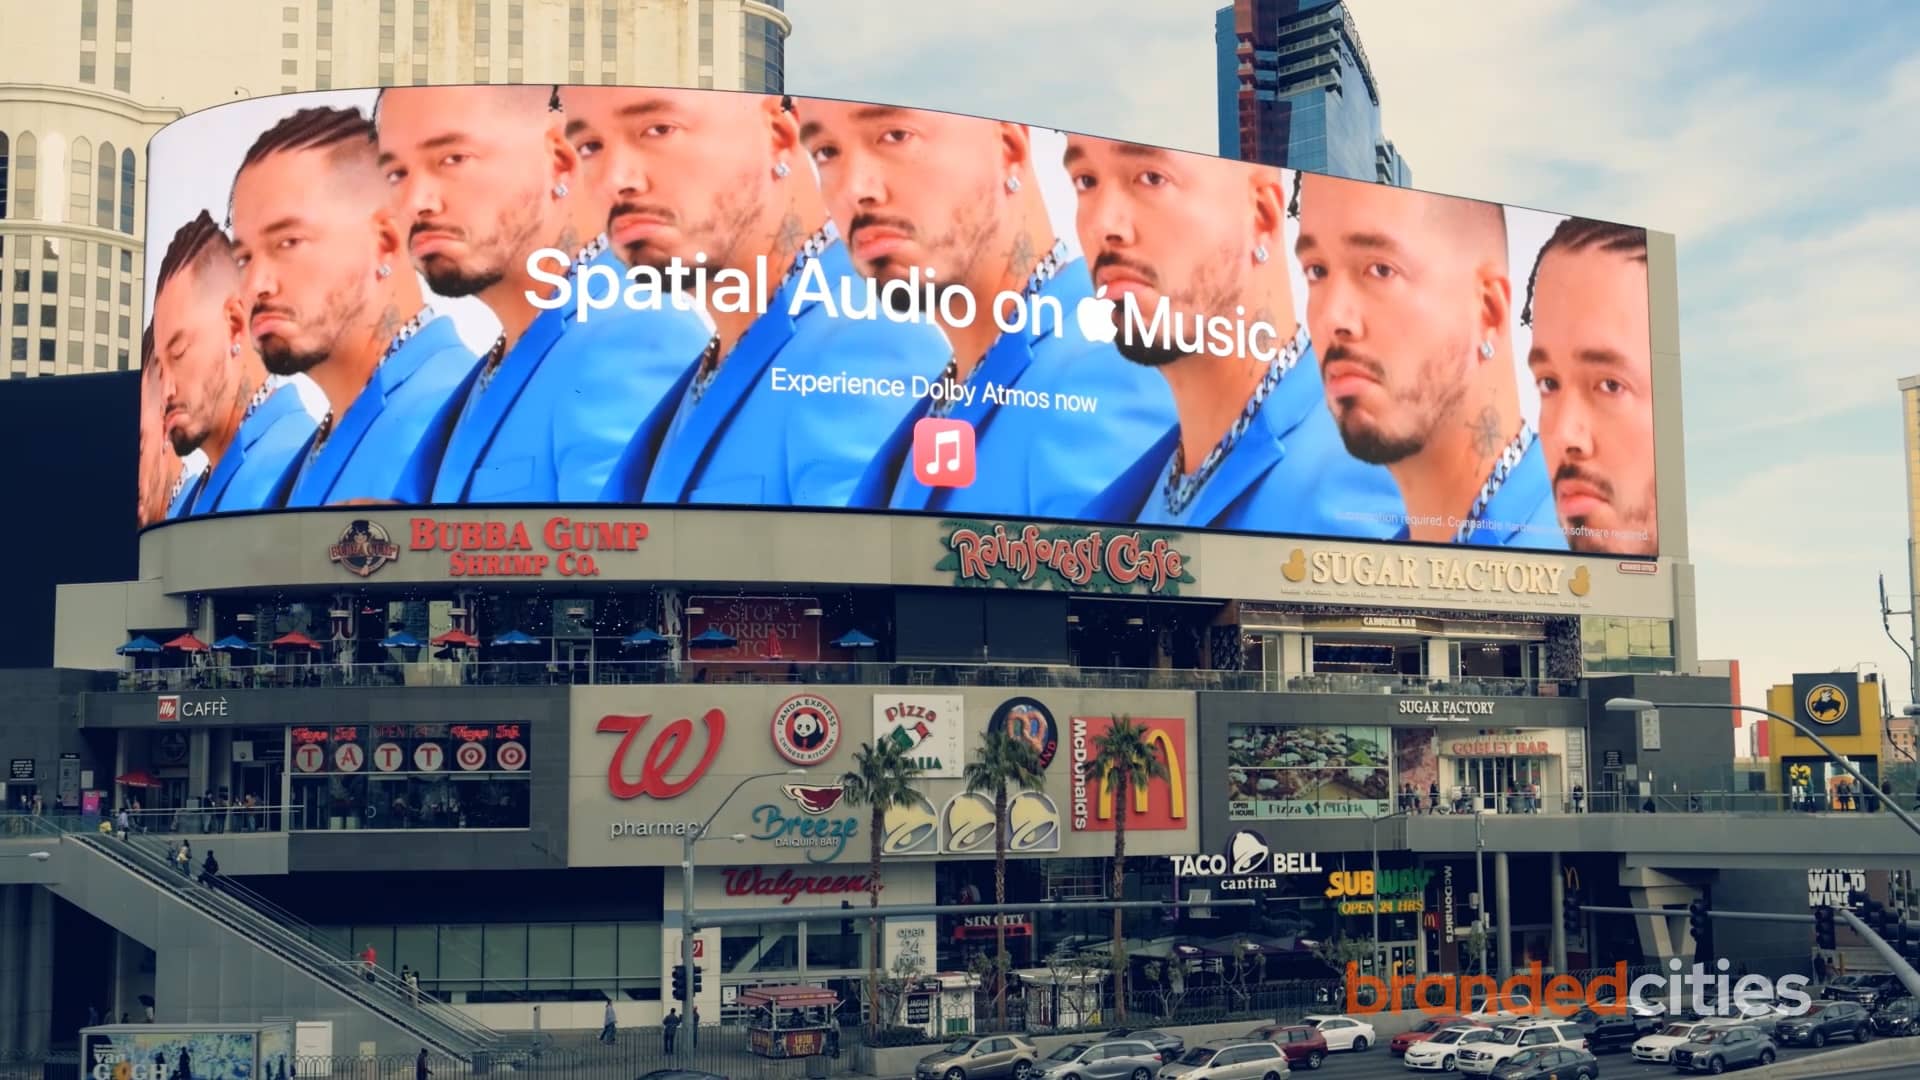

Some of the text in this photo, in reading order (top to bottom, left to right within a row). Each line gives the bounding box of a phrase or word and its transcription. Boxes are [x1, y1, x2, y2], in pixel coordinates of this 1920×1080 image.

[524, 246, 768, 323] Spatial
[789, 256, 976, 331] Audio
[992, 291, 1064, 339] on
[770, 367, 1098, 414] Experience Dolby Atmos now
[409, 517, 533, 551] BUBBA
[543, 516, 649, 551] GUMP
[449, 551, 549, 577] SHRIMP
[951, 524, 1184, 593] Rainforest Cafe
[1311, 550, 1565, 595] SUGAR FACTORY
[729, 602, 780, 622] STOP
[159, 701, 176, 719] illy
[777, 698, 837, 727] PANDA EXPRESS
[1398, 699, 1496, 715] SUGAR FACTORY
[778, 737, 835, 760] CHINESE KITCHEN
[1515, 741, 1549, 755] BAR
[1072, 718, 1088, 831] McDonald's
[750, 804, 858, 864] Breeze
[820, 838, 840, 848] BAR
[1169, 852, 1323, 877] TACO BELL
[1221, 876, 1278, 890] cantina
[1324, 867, 1437, 899] SUBWAY
[1808, 873, 1866, 892] WILD
[1341, 902, 1375, 915] OPEN
[964, 915, 991, 927] SIN
[896, 928, 926, 939] open
[900, 938, 920, 956] 24
[94, 1053, 127, 1064] van
